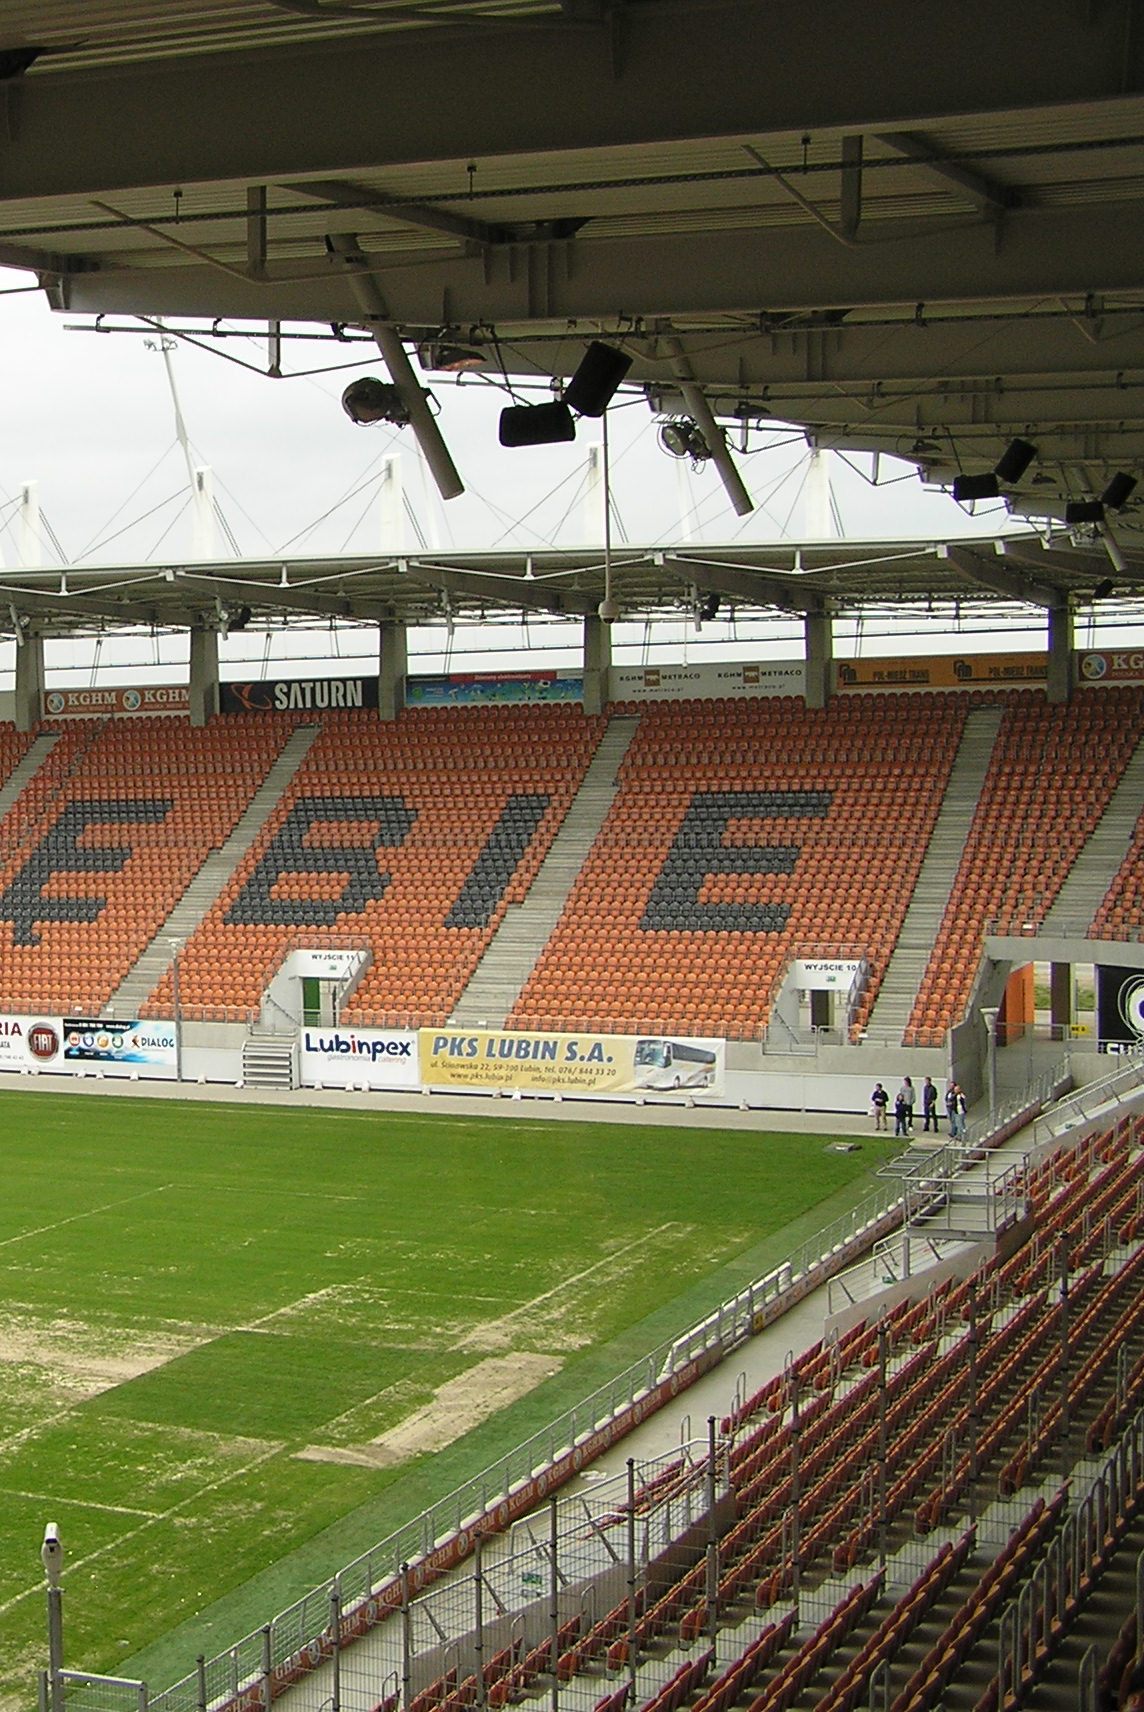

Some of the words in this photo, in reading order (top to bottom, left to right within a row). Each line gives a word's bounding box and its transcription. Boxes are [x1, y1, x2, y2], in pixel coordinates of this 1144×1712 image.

[67, 691, 118, 706] KGHM
[274, 680, 363, 710] SATURN
[803, 963, 844, 971] WYJŚCIE
[846, 964, 857, 972] 10
[33, 1033, 53, 1052] FIAT
[140, 1037, 175, 1048] DIALOG
[305, 1032, 412, 1062] Lubinpex
[432, 1036, 479, 1058] PKS
[486, 1038, 558, 1060] LUBIN
[564, 1040, 614, 1063] S.A.
